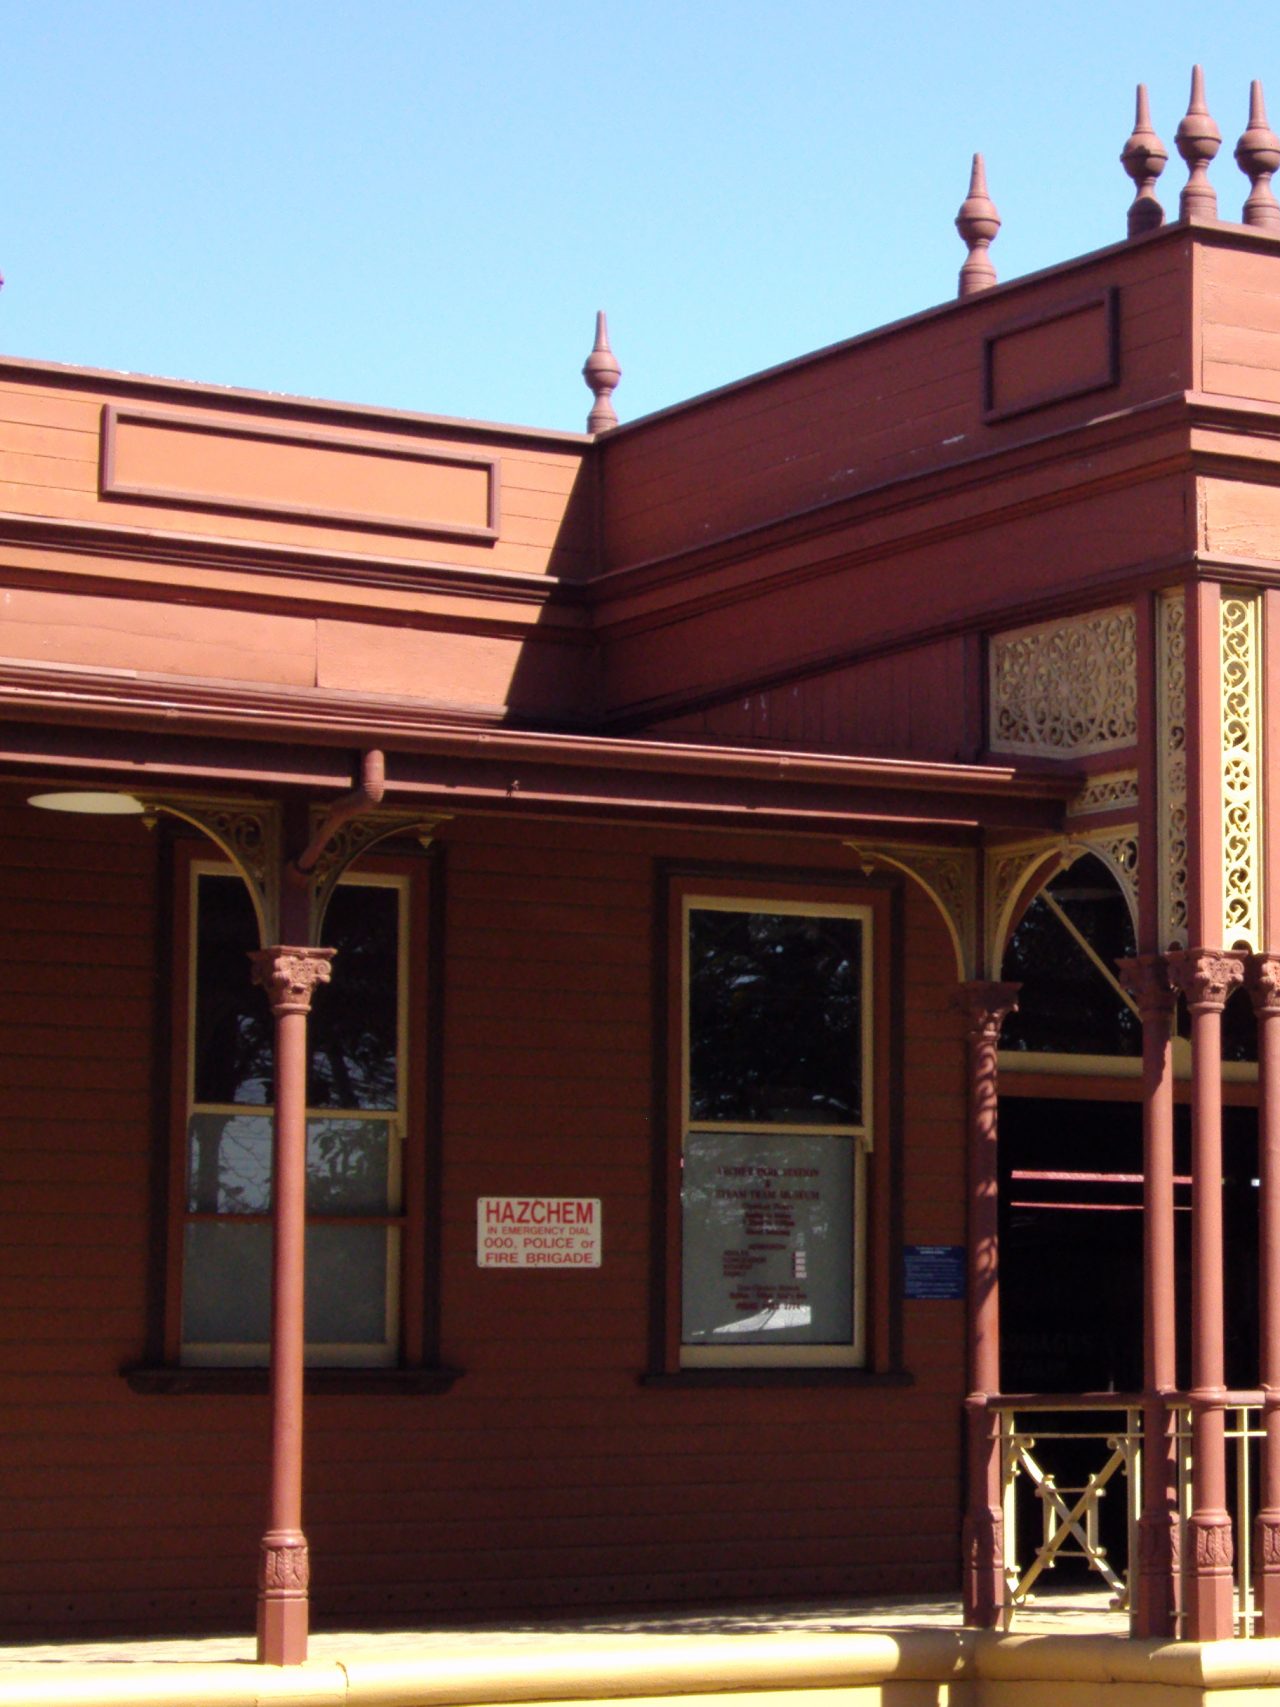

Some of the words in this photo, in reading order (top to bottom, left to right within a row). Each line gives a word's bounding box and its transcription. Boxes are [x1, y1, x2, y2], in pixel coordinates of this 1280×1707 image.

[485, 1200, 594, 1225] HAZCHEM
[487, 1226, 497, 1235] IN
[502, 1226, 565, 1235] EMERGENCY
[569, 1226, 591, 1236] DIAL
[523, 1237, 574, 1249] POLICE
[581, 1239, 595, 1249] or
[485, 1252, 519, 1264] FIRE
[526, 1252, 593, 1264] BRIGADE
